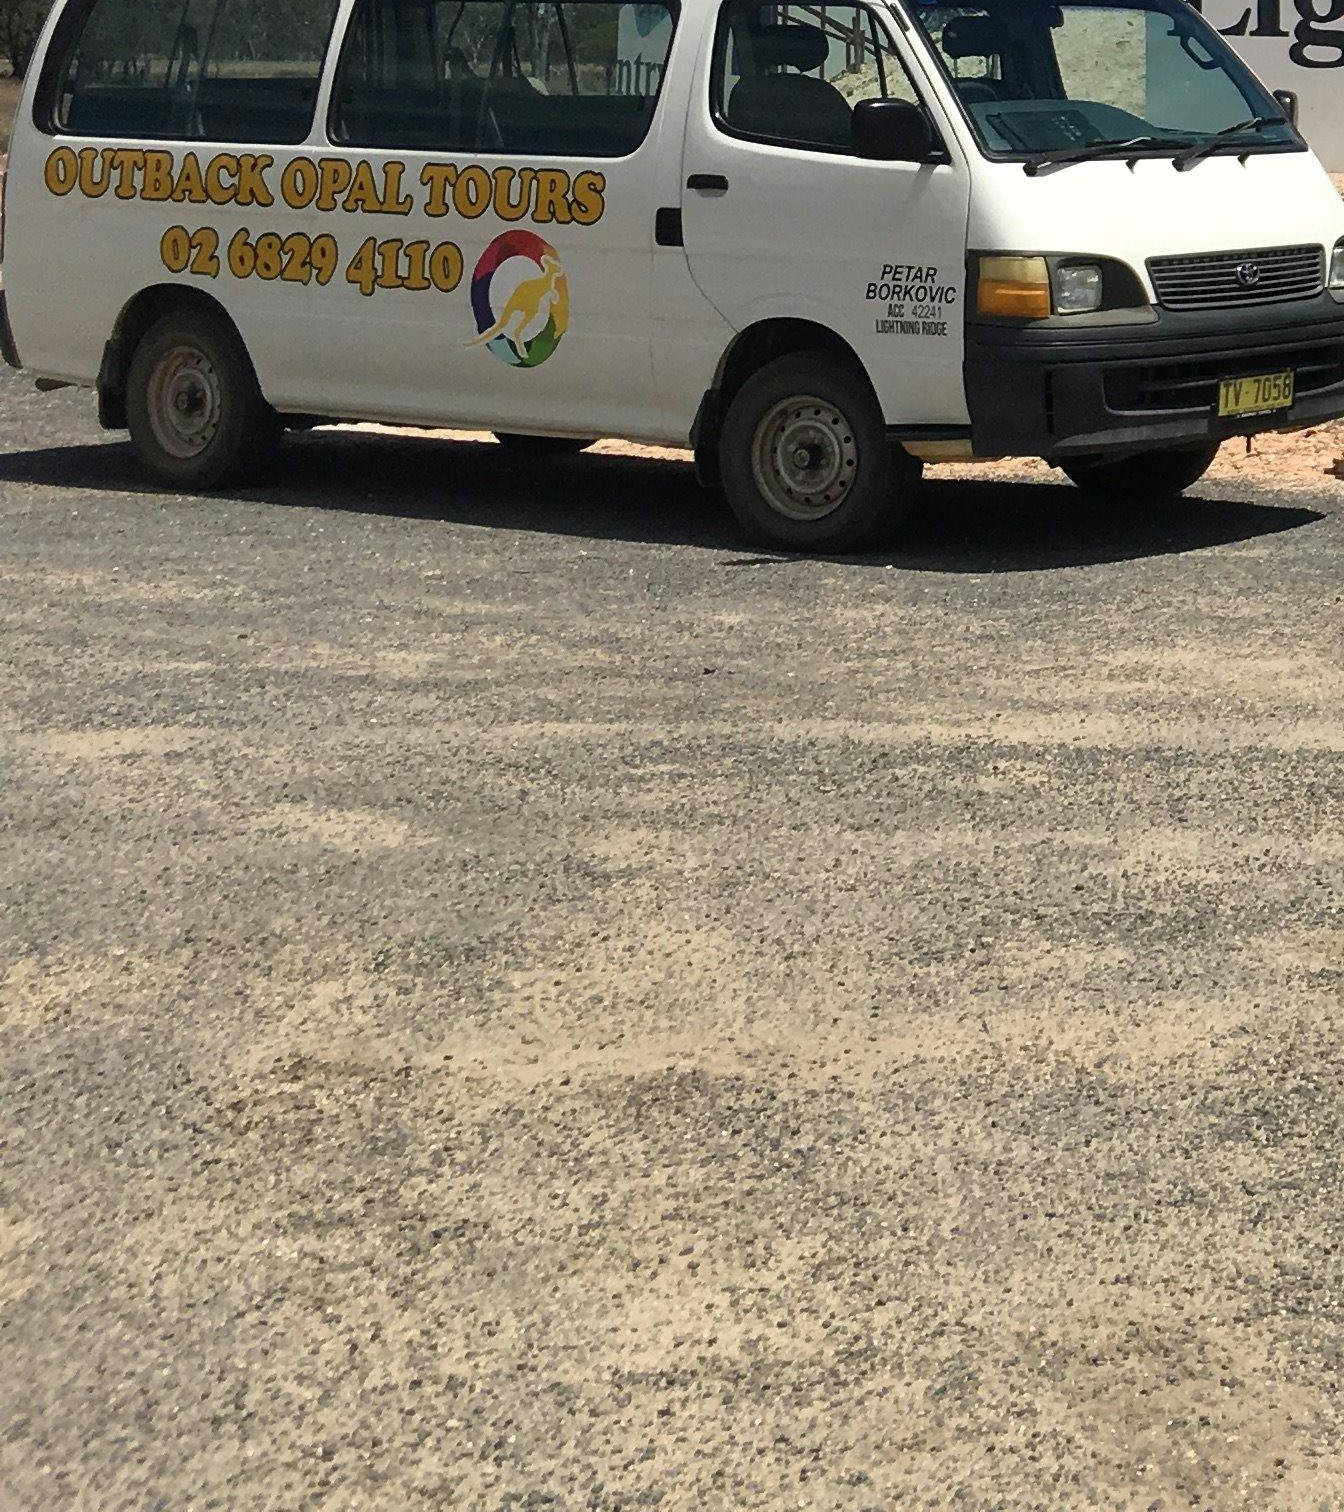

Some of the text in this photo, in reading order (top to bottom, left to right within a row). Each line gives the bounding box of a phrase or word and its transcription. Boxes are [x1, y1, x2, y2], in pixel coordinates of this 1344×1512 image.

[44, 146, 606, 225] OUTBACK OPAL TOURS
[160, 225, 464, 296] 02 6829 4110
[881, 264, 938, 284] PETAR
[866, 282, 957, 304] BORKOVIC
[911, 304, 942, 319] 42241
[876, 319, 948, 337] LIGHTNING RIDGE
